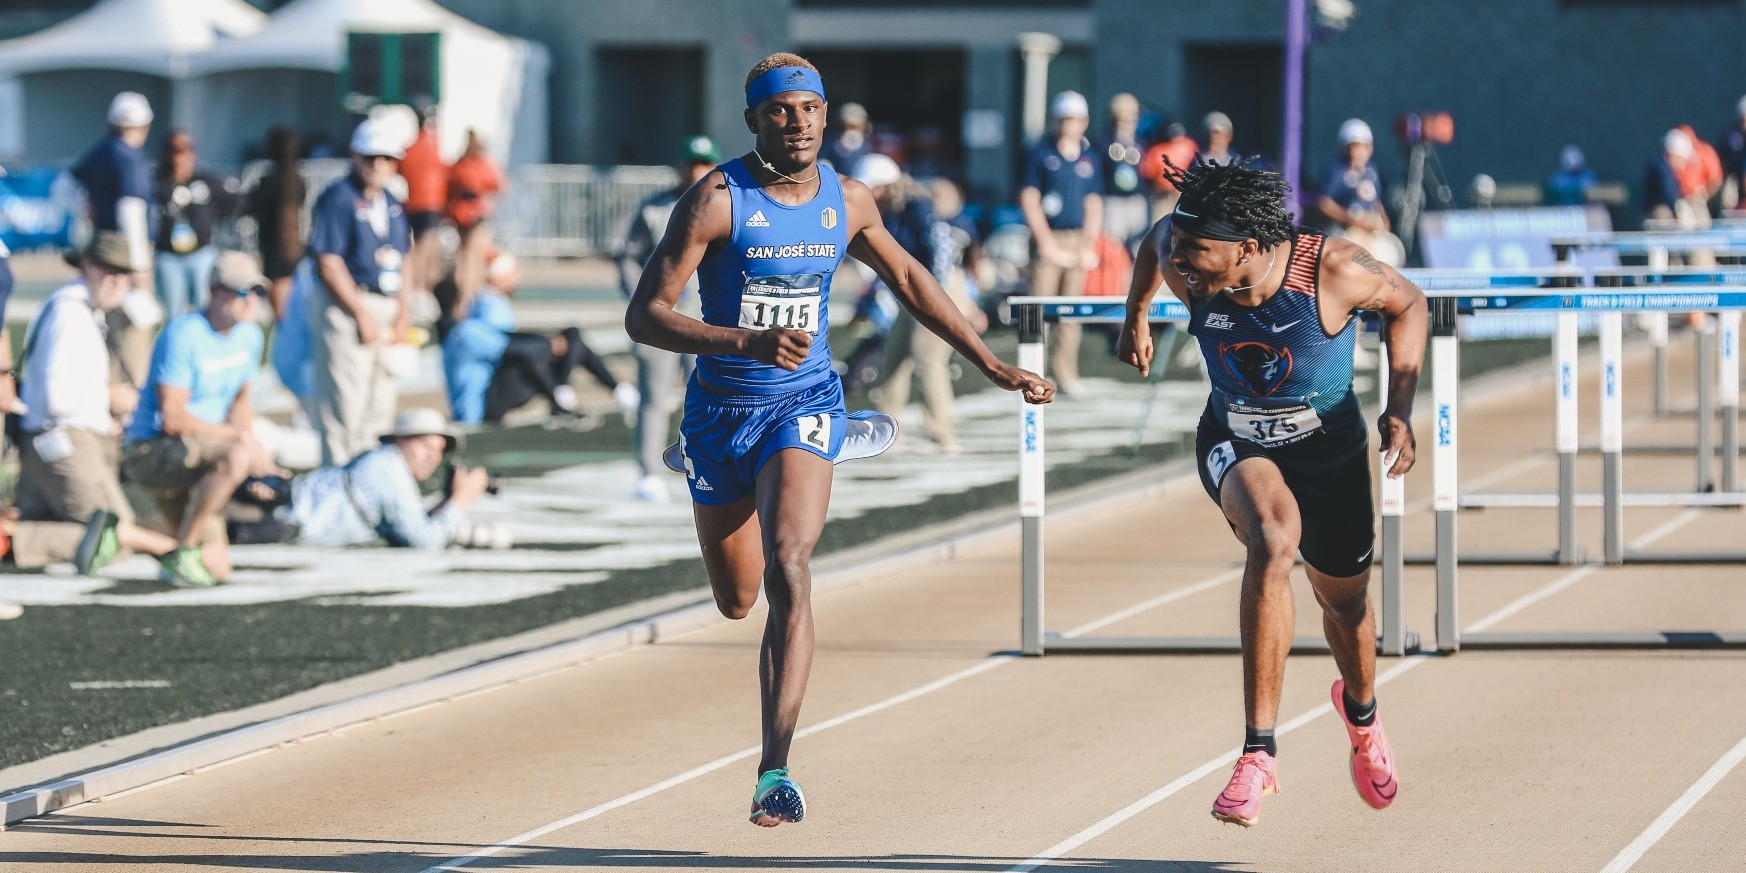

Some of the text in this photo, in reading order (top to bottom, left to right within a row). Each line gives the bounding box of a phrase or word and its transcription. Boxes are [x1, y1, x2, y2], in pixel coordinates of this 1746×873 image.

[746, 240, 836, 259] SAN JOSÉ STATE
[1582, 295, 1609, 308] TRACK
[1618, 295, 1643, 308] FIELD
[1644, 294, 1719, 308] CHAMPIONSHIPS
[753, 303, 810, 328] 1115
[1205, 319, 1235, 329] EAST
[1208, 313, 1229, 322] BIG
[807, 415, 824, 447] 2
[1249, 416, 1299, 440] 375
[1439, 403, 1450, 446] NCAA
[1210, 446, 1228, 480] 3
